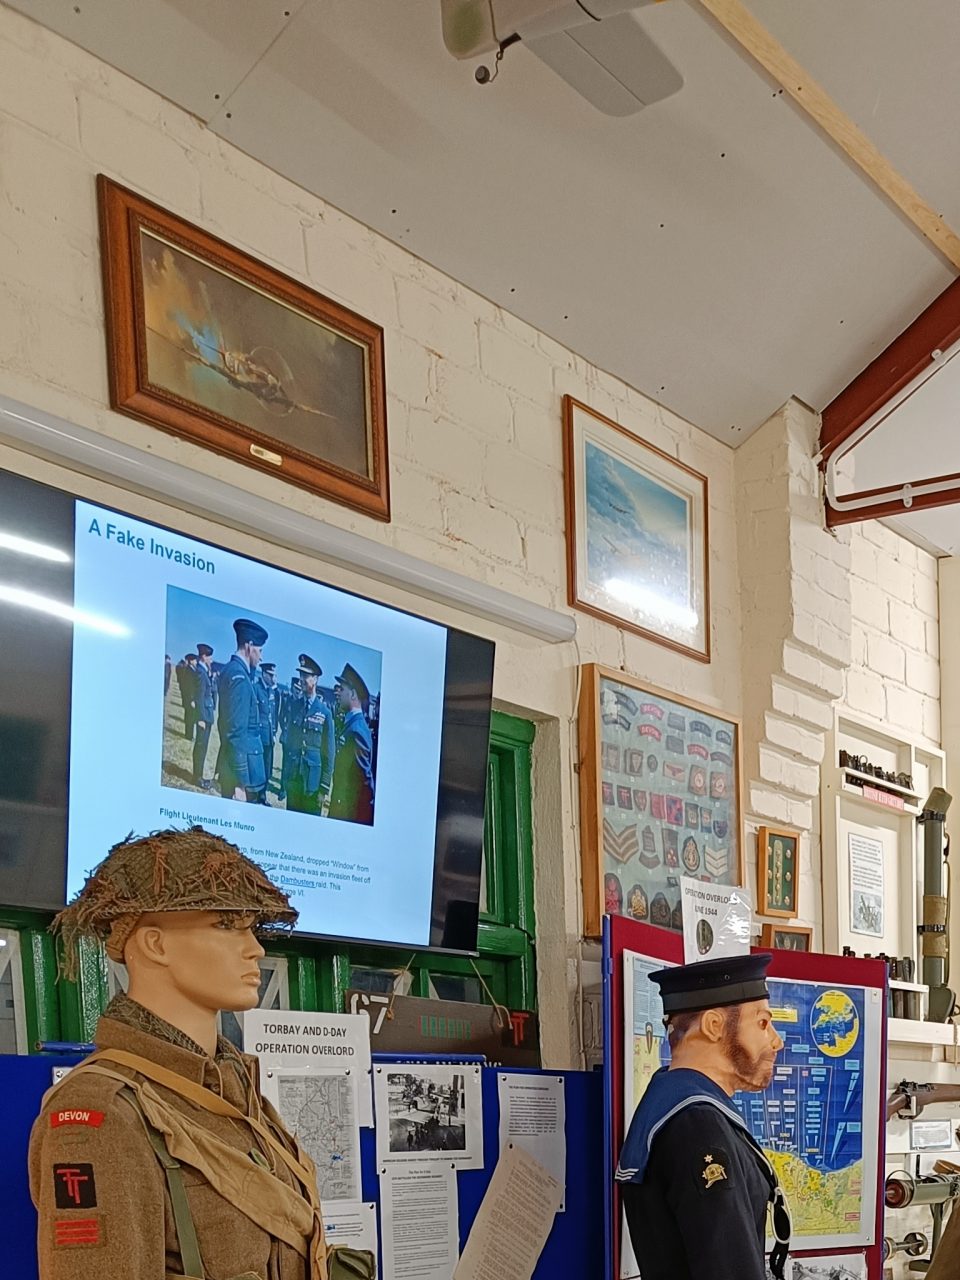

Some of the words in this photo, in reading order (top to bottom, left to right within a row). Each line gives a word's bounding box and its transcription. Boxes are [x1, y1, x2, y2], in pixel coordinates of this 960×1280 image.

[88, 518, 102, 537] A
[106, 523, 145, 551] Fake
[150, 538, 215, 575] Invasion
[159, 807, 180, 819] Flight
[182, 812, 219, 826] Lieutenant
[220, 819, 232, 828] Les
[233, 821, 255, 832] Munro
[250, 847, 265, 856] from
[265, 849, 279, 859] New
[280, 851, 305, 863] Zealand,
[306, 856, 330, 867] dropped
[357, 863, 370, 872] from
[279, 863, 291, 872] that
[291, 865, 306, 875] there
[328, 871, 351, 882] invasion
[351, 875, 363, 883] fleet
[281, 875, 315, 887] Dambusters
[329, 882, 341, 891] This
[263, 1023, 301, 1035] TORBAY
[302, 1026, 322, 1036] AND
[323, 1027, 347, 1038] D-DAY
[255, 1043, 310, 1055] OPERATION
[311, 1045, 355, 1056] OVERLORD
[58, 1111, 90, 1122] DEVON
